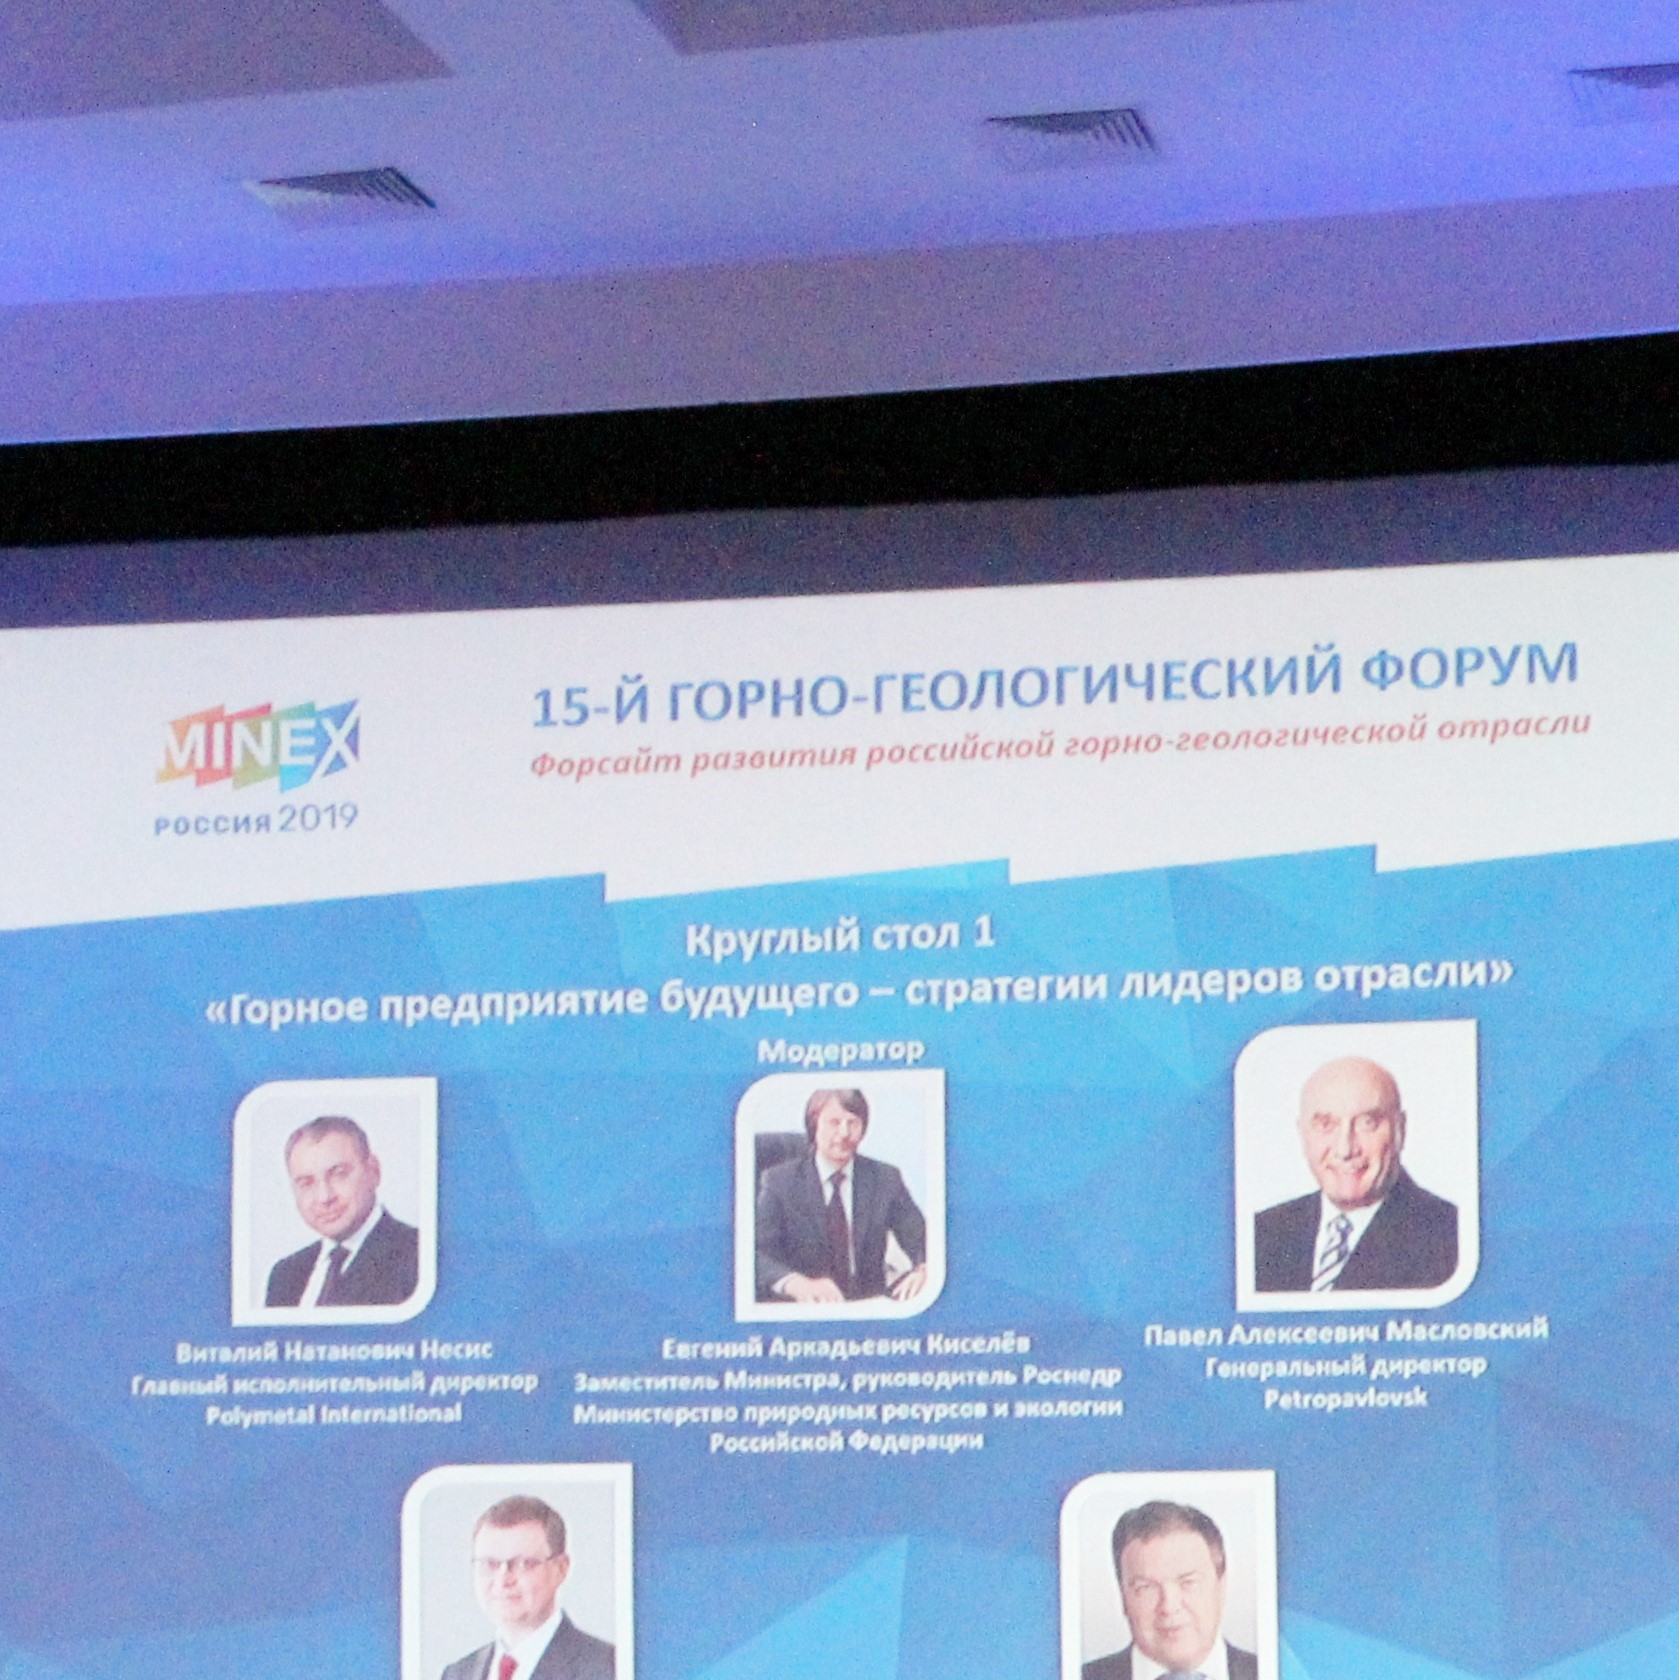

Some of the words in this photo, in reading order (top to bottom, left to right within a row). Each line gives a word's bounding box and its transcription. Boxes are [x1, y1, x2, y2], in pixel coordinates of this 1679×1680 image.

[531, 674, 650, 729] 15-Й
[669, 643, 1342, 724] ГОРНО-ГЕОЛОГИЧЕСКИЙ
[1362, 641, 1579, 695] ФОРУМ
[156, 697, 360, 794] MINEX
[531, 743, 683, 782] Форсайт
[691, 741, 857, 776] развития
[866, 731, 1054, 771] российской
[1065, 714, 1428, 760] горно-геологической
[1438, 711, 1593, 742] отрасли
[155, 813, 271, 838] РОССИЯ
[279, 804, 359, 834] 2019
[685, 917, 860, 963] Круглый
[872, 922, 960, 951] стол
[974, 915, 995, 946] 1
[206, 993, 369, 1033] «Горное
[380, 986, 648, 1027] предприятие
[660, 978, 860, 1020] будущего
[905, 970, 1109, 1007] стратегии
[1120, 965, 1303, 1004] лидеров
[1315, 954, 1515, 994] отрасли»
[758, 1034, 925, 1070] Модератор
[662, 1336, 763, 1359] Евгений
[769, 1335, 921, 1361] Аркадьевич
[928, 1331, 1031, 1356] Киселёв
[1144, 1324, 1223, 1346] Павел
[1228, 1321, 1380, 1346] Алексеевич
[1386, 1316, 1549, 1342] Масловский
[176, 1340, 278, 1364] Виталий
[284, 1340, 415, 1363] Натанович
[420, 1338, 493, 1360] Несис
[573, 1371, 718, 1394] Заместитель
[725, 1369, 848, 1393] Министра,
[853, 1367, 1017, 1392] руководитель
[1022, 1365, 1122, 1389] Роснедр
[1205, 1354, 1366, 1379] Генеральный
[1370, 1356, 1487, 1379] директор
[131, 1372, 228, 1397] Главный
[233, 1370, 425, 1395] исполнительный
[430, 1373, 539, 1397] директор
[1264, 1385, 1428, 1412] Petropavlovsk
[206, 1405, 315, 1429] Polymetal
[321, 1402, 462, 1425] International
[573, 1404, 738, 1427] Министерство
[744, 1401, 876, 1425] природных
[882, 1400, 987, 1424] ресурсов
[993, 1401, 1008, 1418] и
[1014, 1397, 1124, 1419] экологии
[710, 1431, 845, 1454] Российской
[849, 1430, 985, 1455] Федерации
